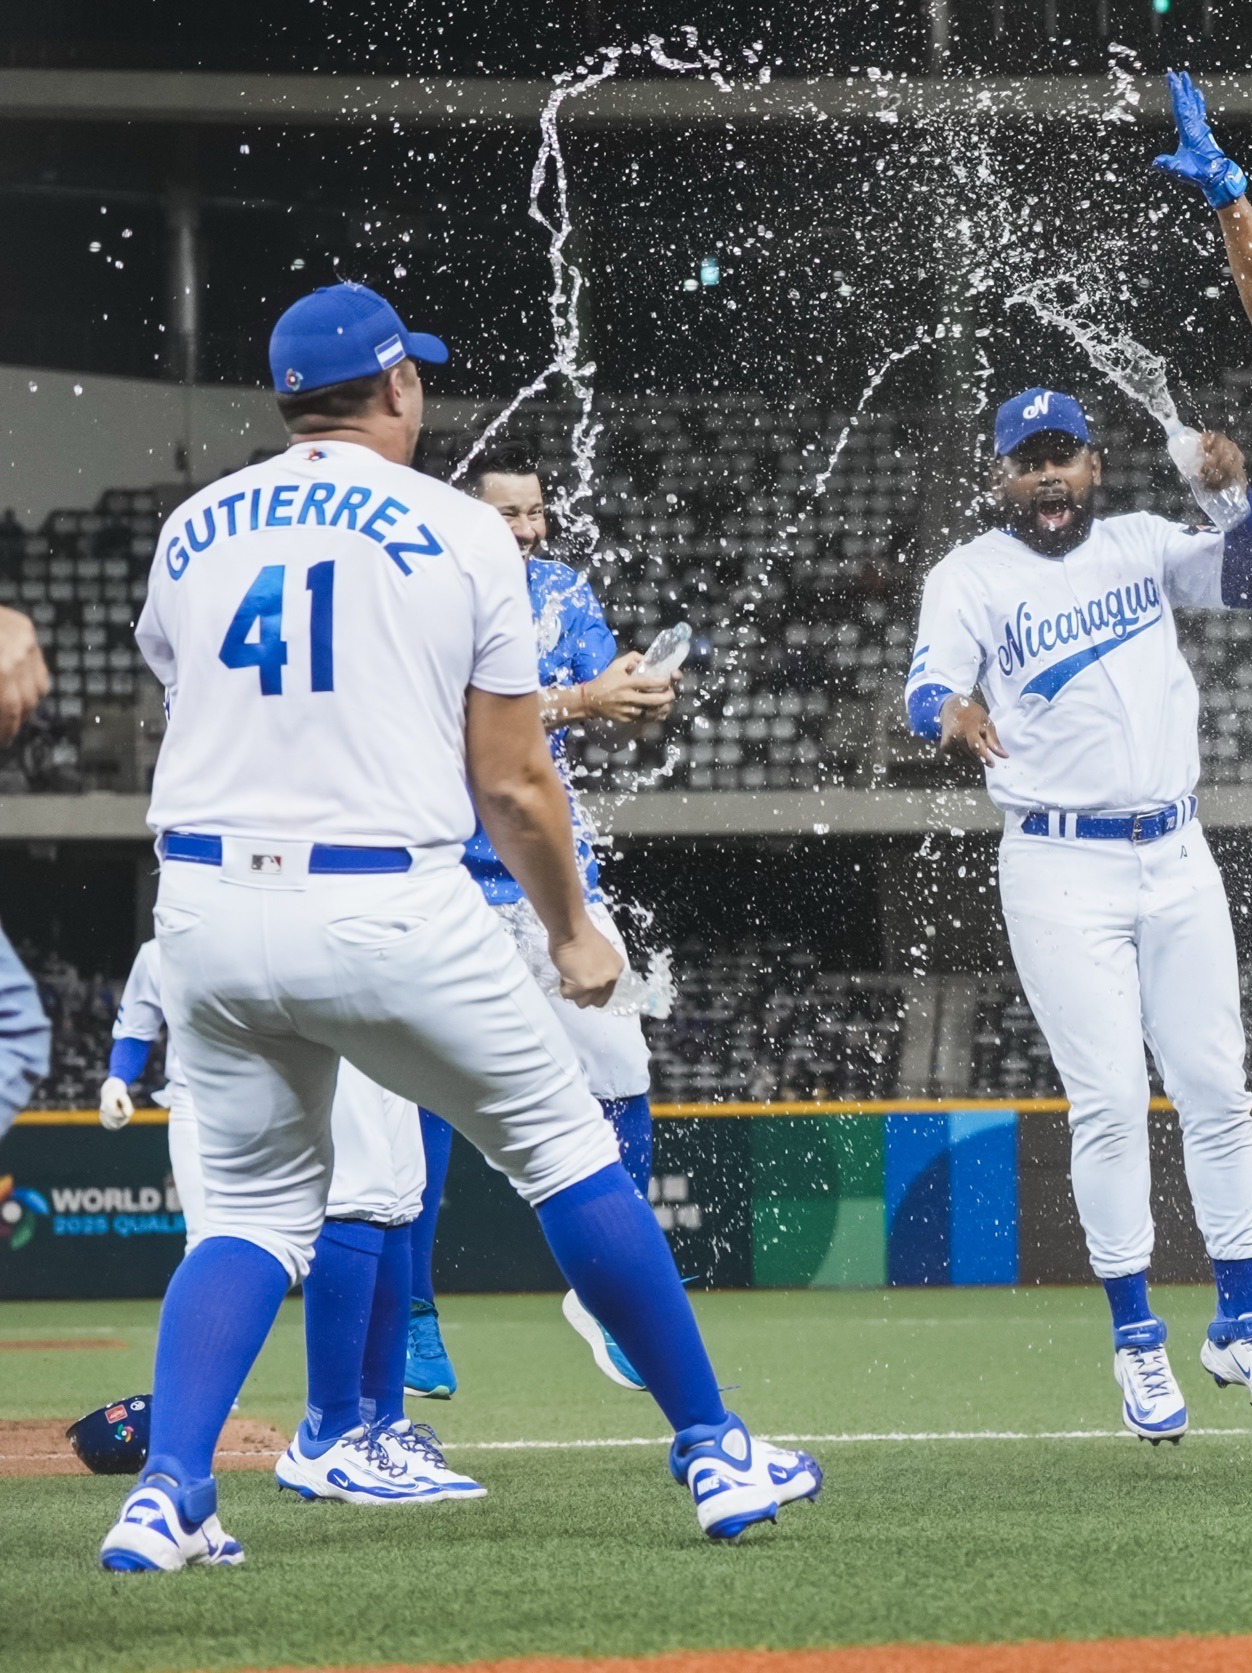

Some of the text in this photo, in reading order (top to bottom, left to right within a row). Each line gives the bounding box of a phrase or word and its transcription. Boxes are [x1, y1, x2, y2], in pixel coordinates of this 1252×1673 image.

[166, 482, 445, 582] GUTIERREZ
[218, 560, 335, 696] 41
[998, 576, 1161, 677] Nicaragua
[51, 1187, 164, 1213] WORLD
